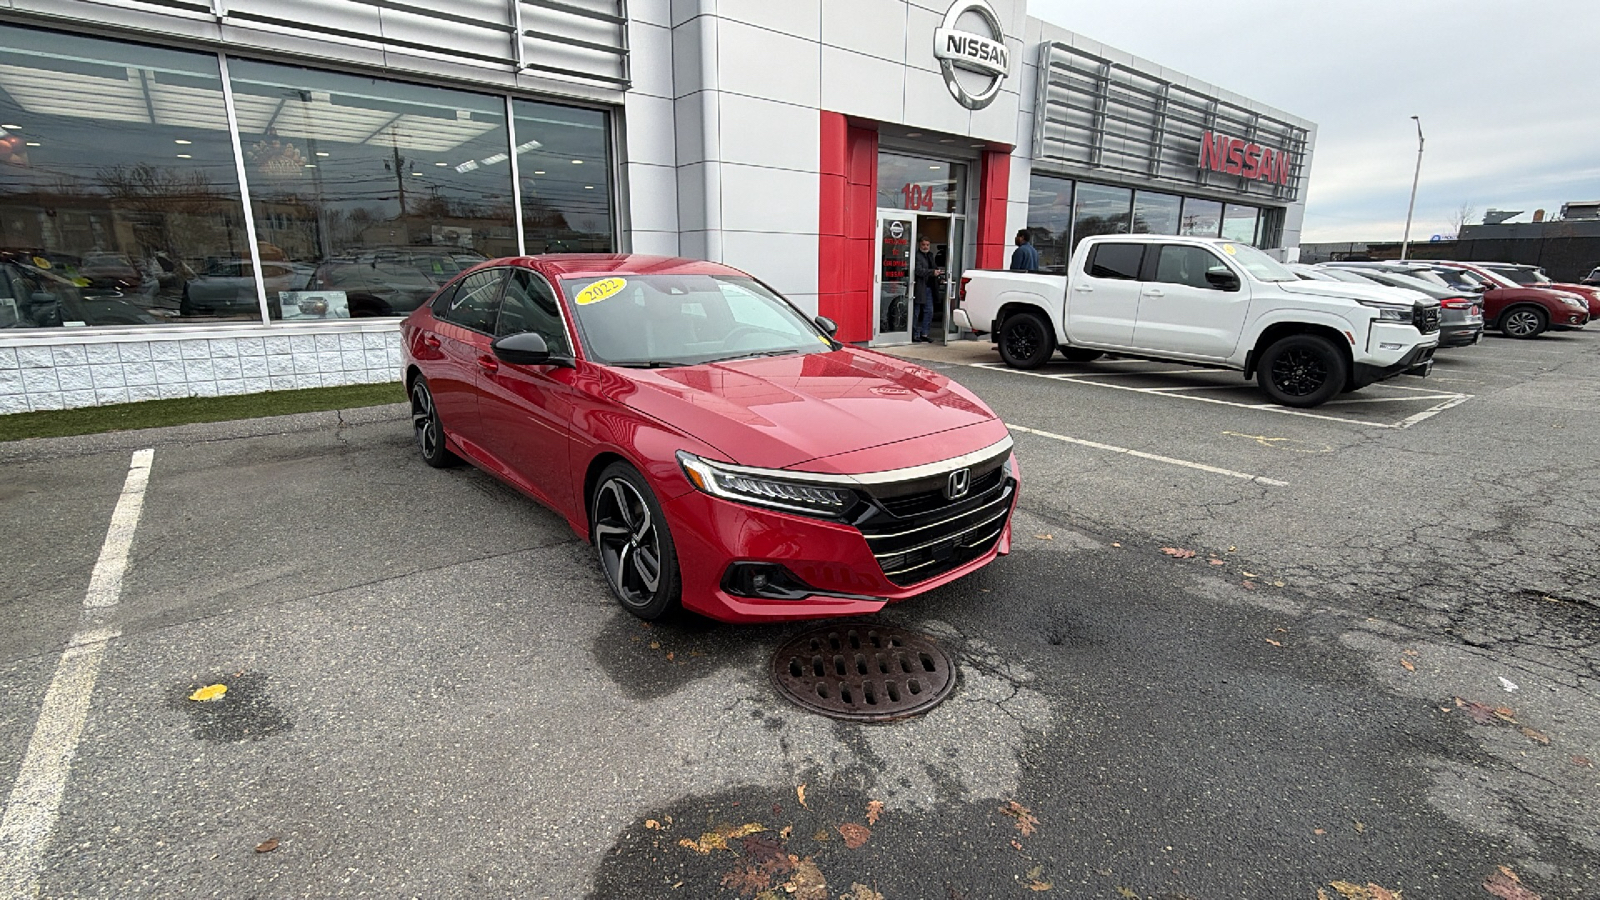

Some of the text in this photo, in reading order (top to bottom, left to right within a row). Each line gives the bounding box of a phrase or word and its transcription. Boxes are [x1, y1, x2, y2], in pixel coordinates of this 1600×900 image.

[946, 34, 1008, 69] NISSAN
[1200, 130, 1291, 186] NISSAN
[901, 182, 934, 212] 104
[885, 270, 905, 278] NISSAN
[584, 280, 618, 300] 2022
